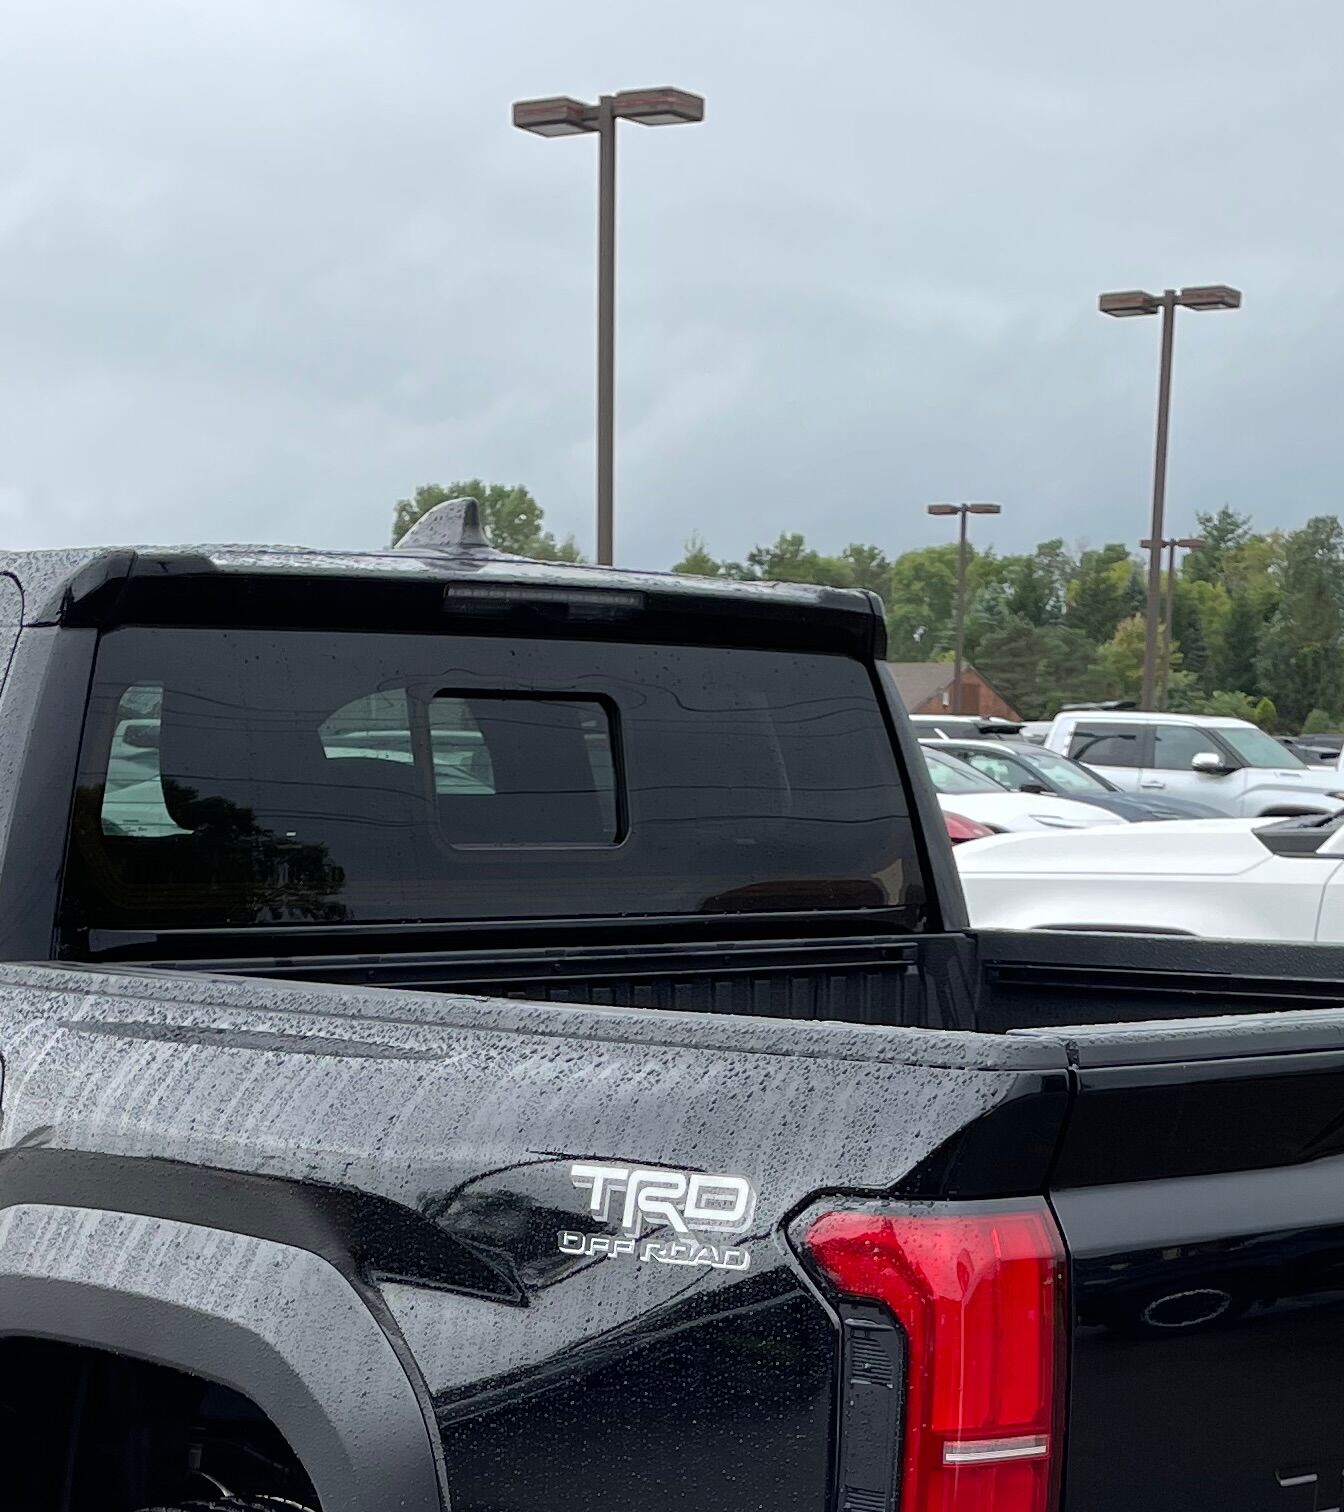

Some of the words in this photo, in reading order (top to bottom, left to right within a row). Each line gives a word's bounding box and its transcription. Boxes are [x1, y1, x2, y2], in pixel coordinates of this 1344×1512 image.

[571, 1164, 756, 1240] TRD
[557, 1231, 635, 1258] OFF
[639, 1242, 751, 1271] ROAD
